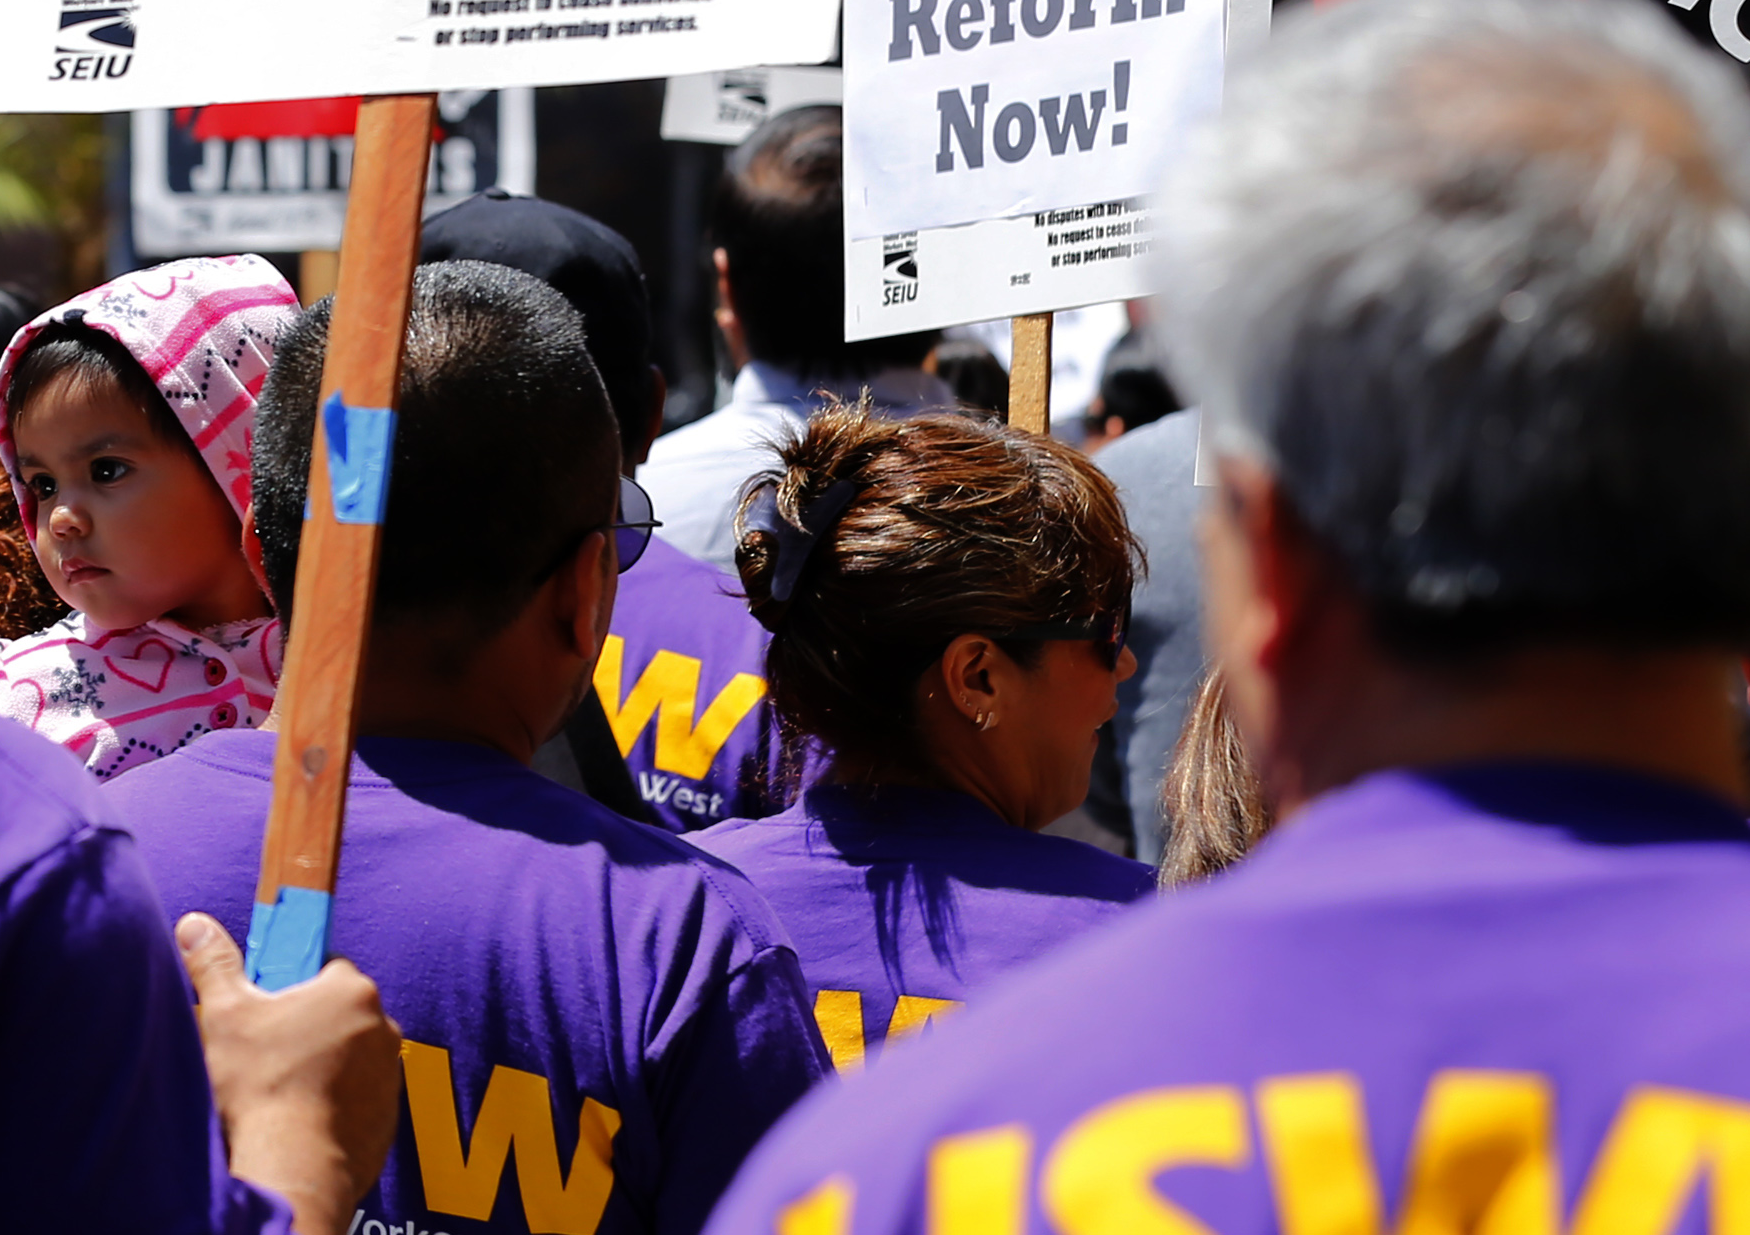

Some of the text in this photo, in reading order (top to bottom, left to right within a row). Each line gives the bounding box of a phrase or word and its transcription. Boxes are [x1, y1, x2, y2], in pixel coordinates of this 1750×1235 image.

[434, 29, 455, 47] or
[460, 25, 500, 46] stop
[504, 19, 610, 44] performing
[48, 54, 134, 81] SEIU
[935, 59, 1131, 174] Now!
[189, 135, 477, 194] JANITS
[1047, 206, 1085, 227] disputes
[1086, 202, 1105, 220] with
[1047, 231, 1059, 247] No
[1060, 226, 1094, 246] request
[1095, 224, 1104, 239] to
[1051, 254, 1062, 268] or
[1062, 250, 1082, 267] stop
[882, 282, 918, 307] SEIU
[638, 770, 725, 817] West
